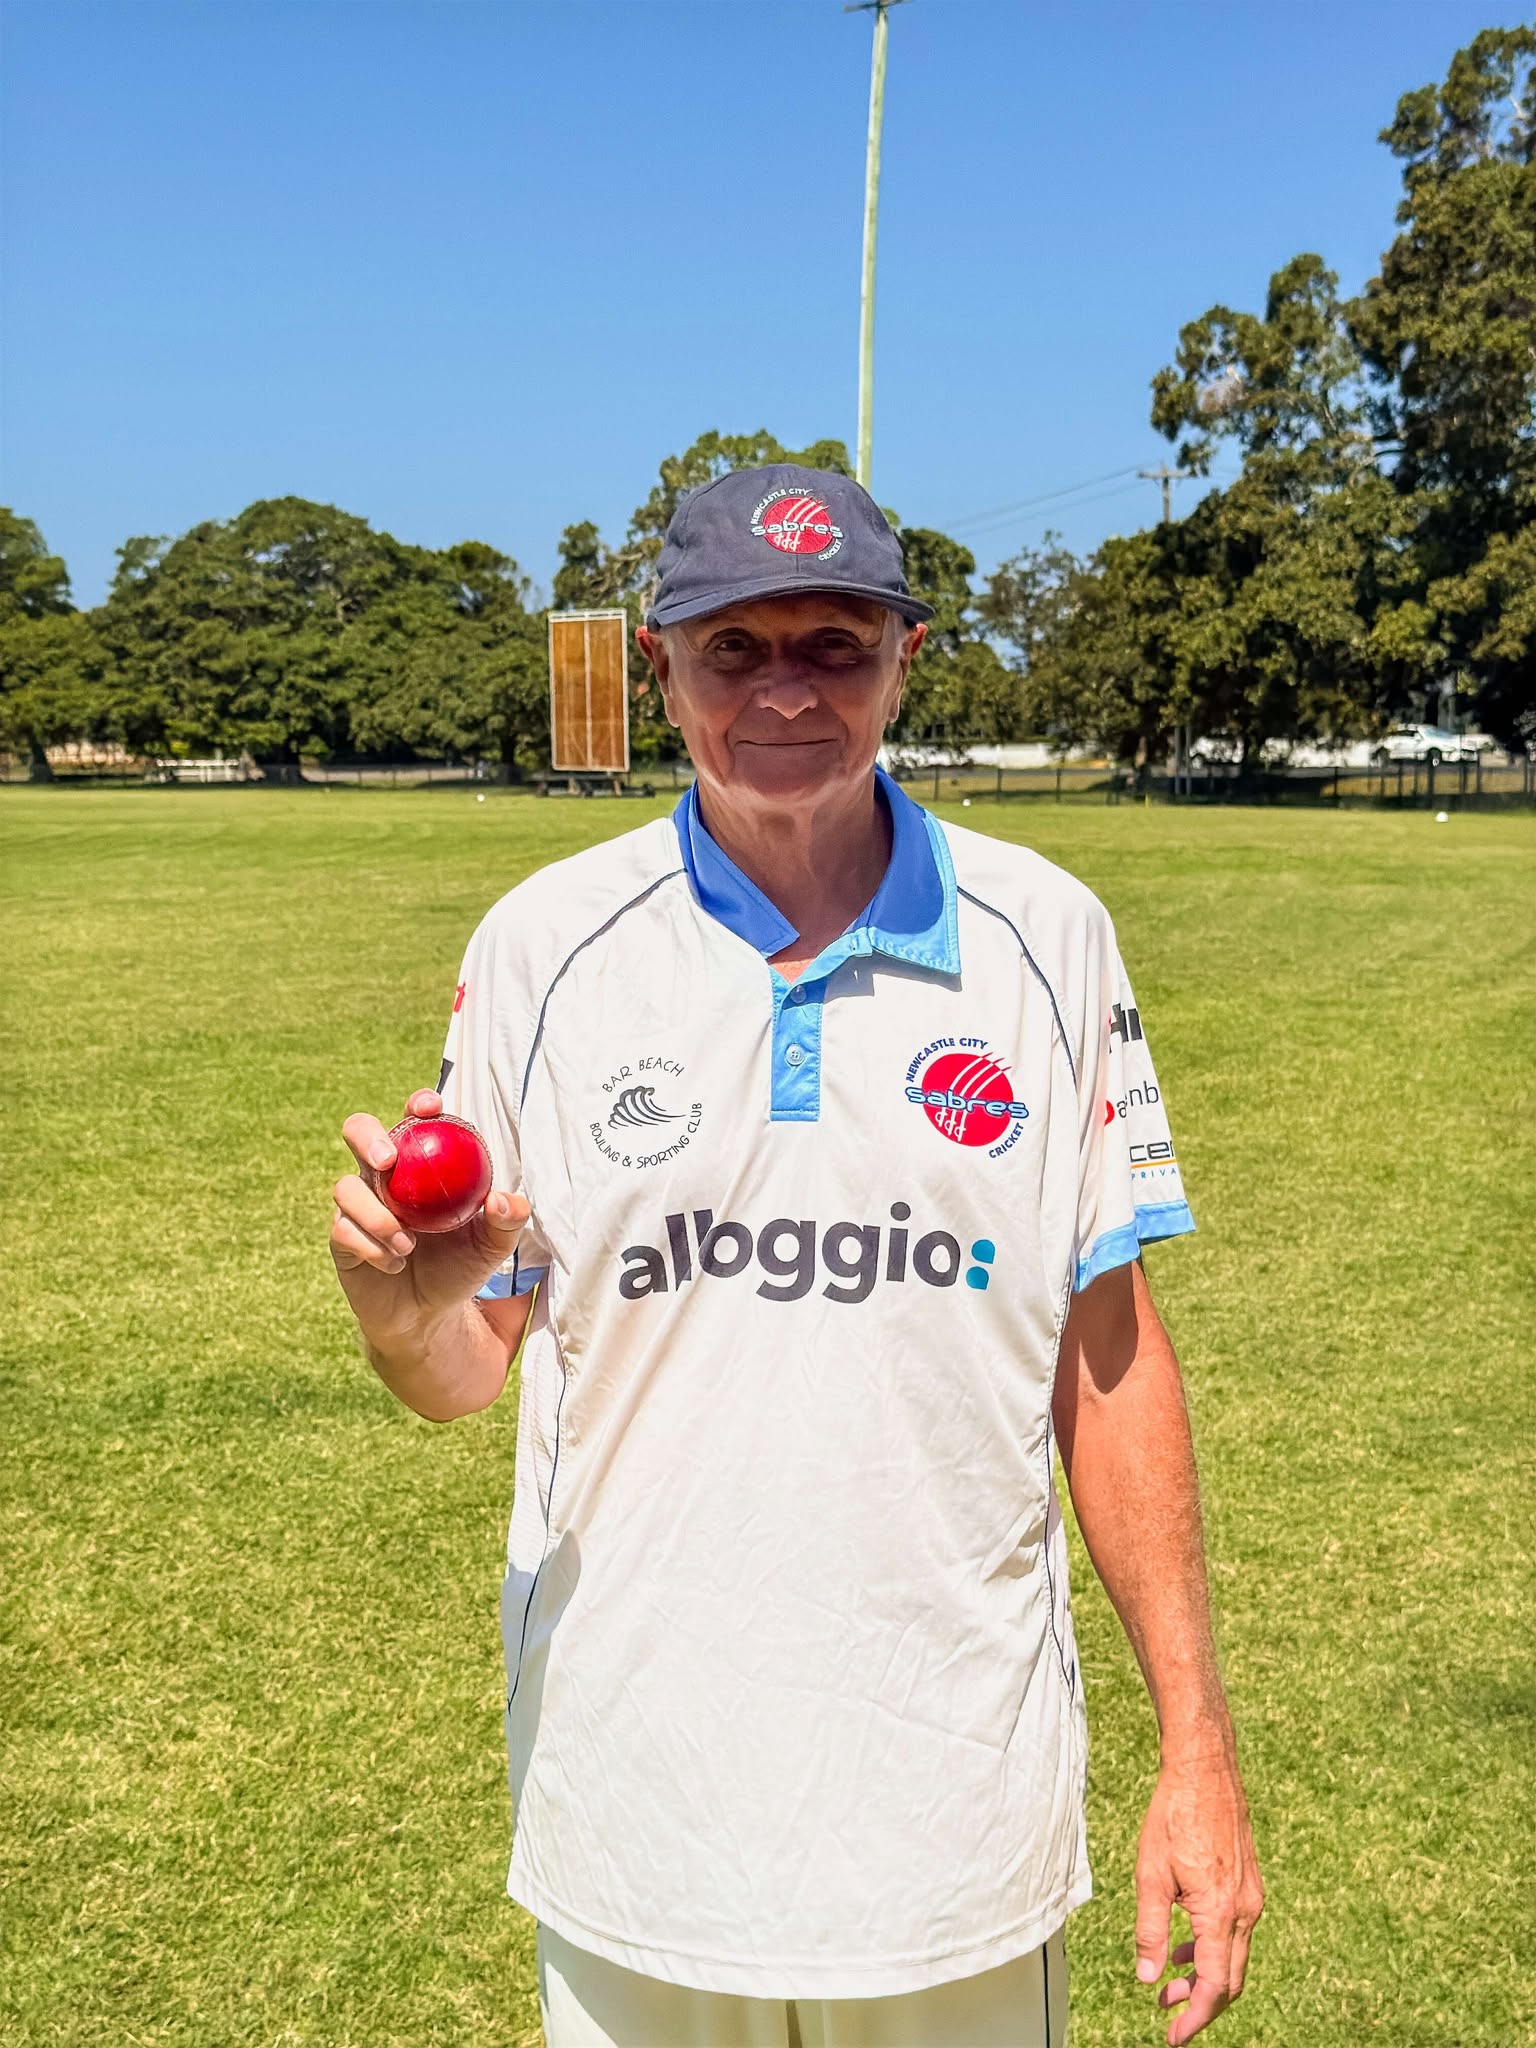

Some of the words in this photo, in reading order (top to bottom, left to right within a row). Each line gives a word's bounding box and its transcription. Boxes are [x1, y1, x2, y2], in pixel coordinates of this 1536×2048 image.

[602, 1066, 632, 1092] BAR
[639, 1057, 685, 1077] BEACH
[906, 1038, 955, 1082] NEWCASTLE
[959, 1038, 988, 1049] CITY
[590, 1122, 620, 1162] BOWLING
[622, 1156, 632, 1168] &
[637, 1135, 690, 1169] SPORTING
[687, 1103, 703, 1133] CLUB
[988, 1123, 1024, 1158] CRICKET
